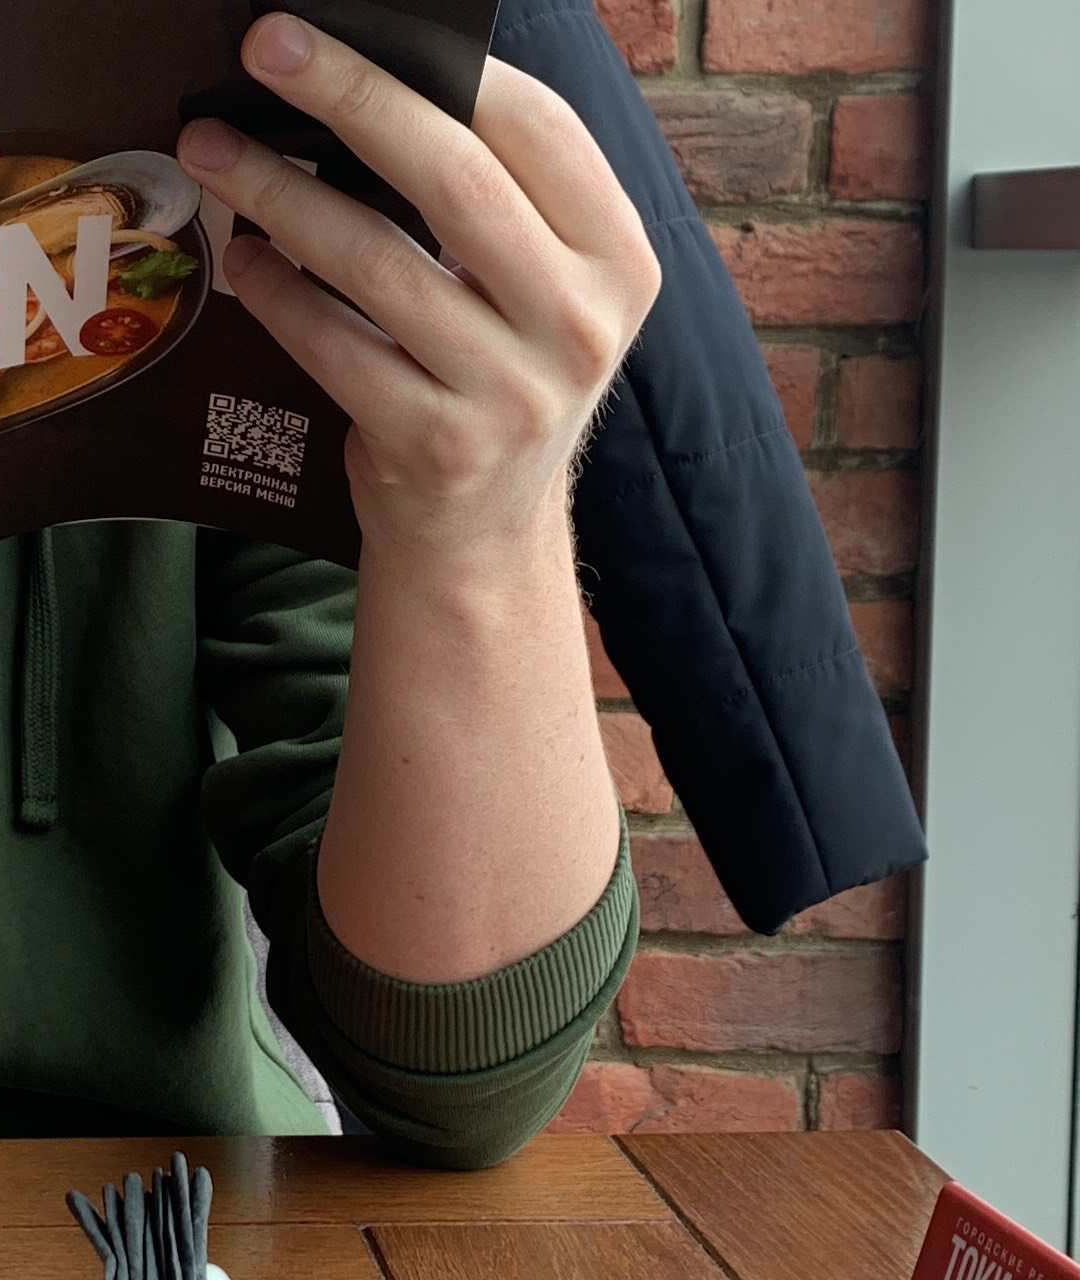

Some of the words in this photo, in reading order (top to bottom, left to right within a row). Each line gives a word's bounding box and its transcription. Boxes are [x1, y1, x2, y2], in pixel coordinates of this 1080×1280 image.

[200, 475, 251, 495] ВЕРСИЯ
[256, 488, 296, 508] МЕНЮ
[202, 462, 298, 495] ЭЛЕКТРОННАЯ
[955, 1217, 1023, 1273] ГОРОДСКИЕ
